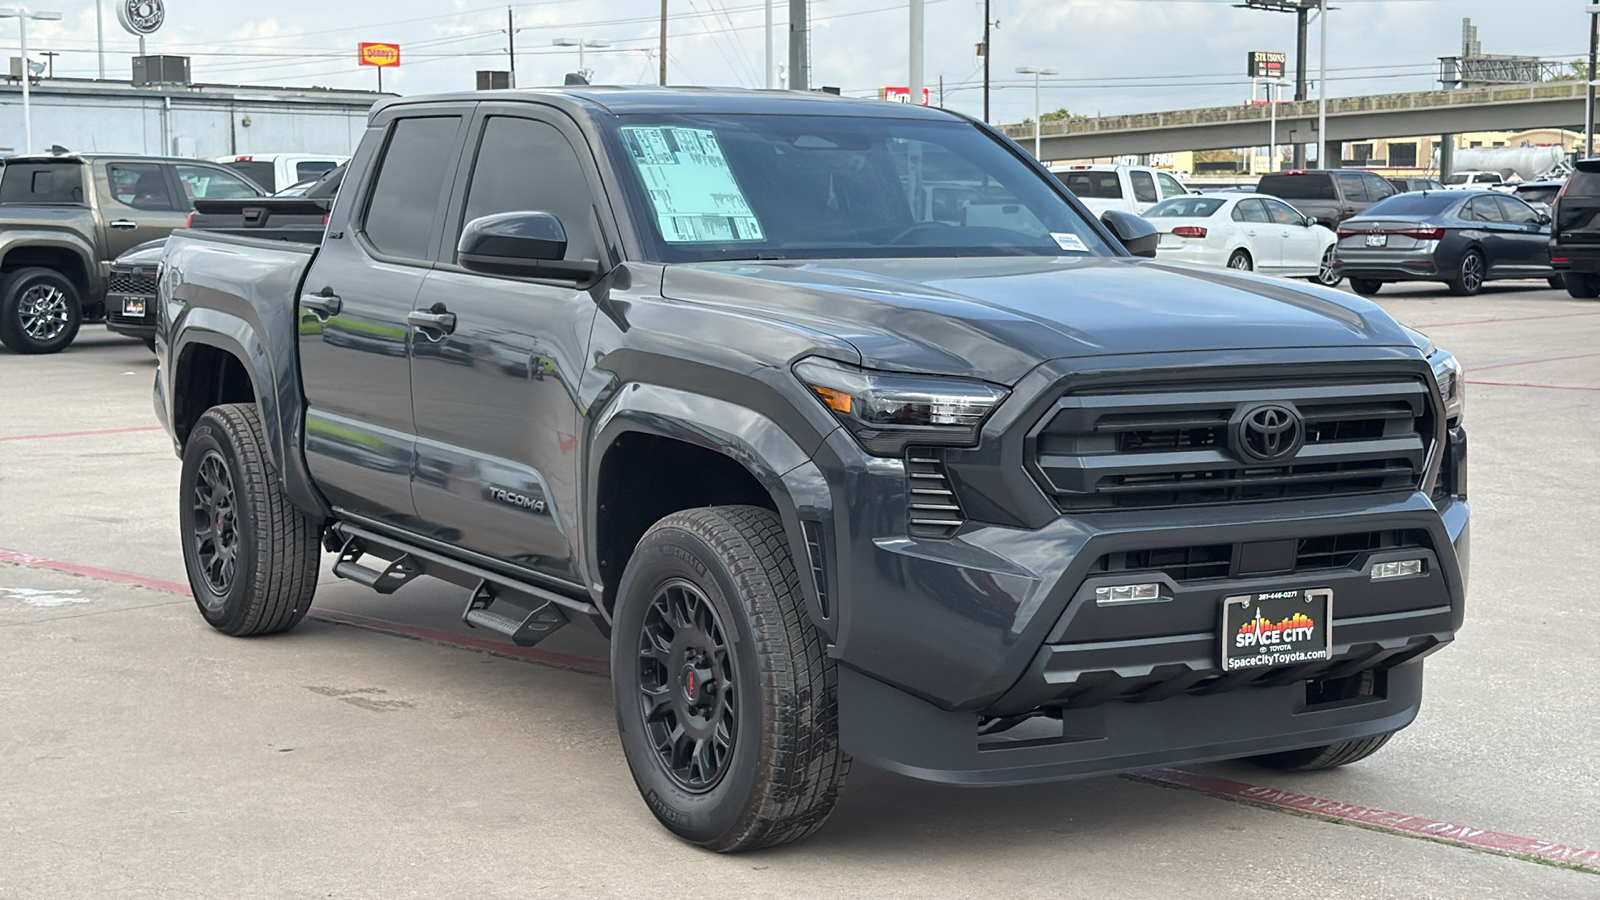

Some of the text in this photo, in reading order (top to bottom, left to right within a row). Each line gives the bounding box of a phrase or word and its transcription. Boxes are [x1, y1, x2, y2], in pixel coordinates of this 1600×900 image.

[489, 486, 544, 512] TACOMA
[662, 545, 708, 577] MICHELIN
[1235, 624, 1314, 647] SPACE CITY
[1269, 644, 1292, 652] TOYOTA
[1228, 650, 1327, 670] SpaceCityToyota.com
